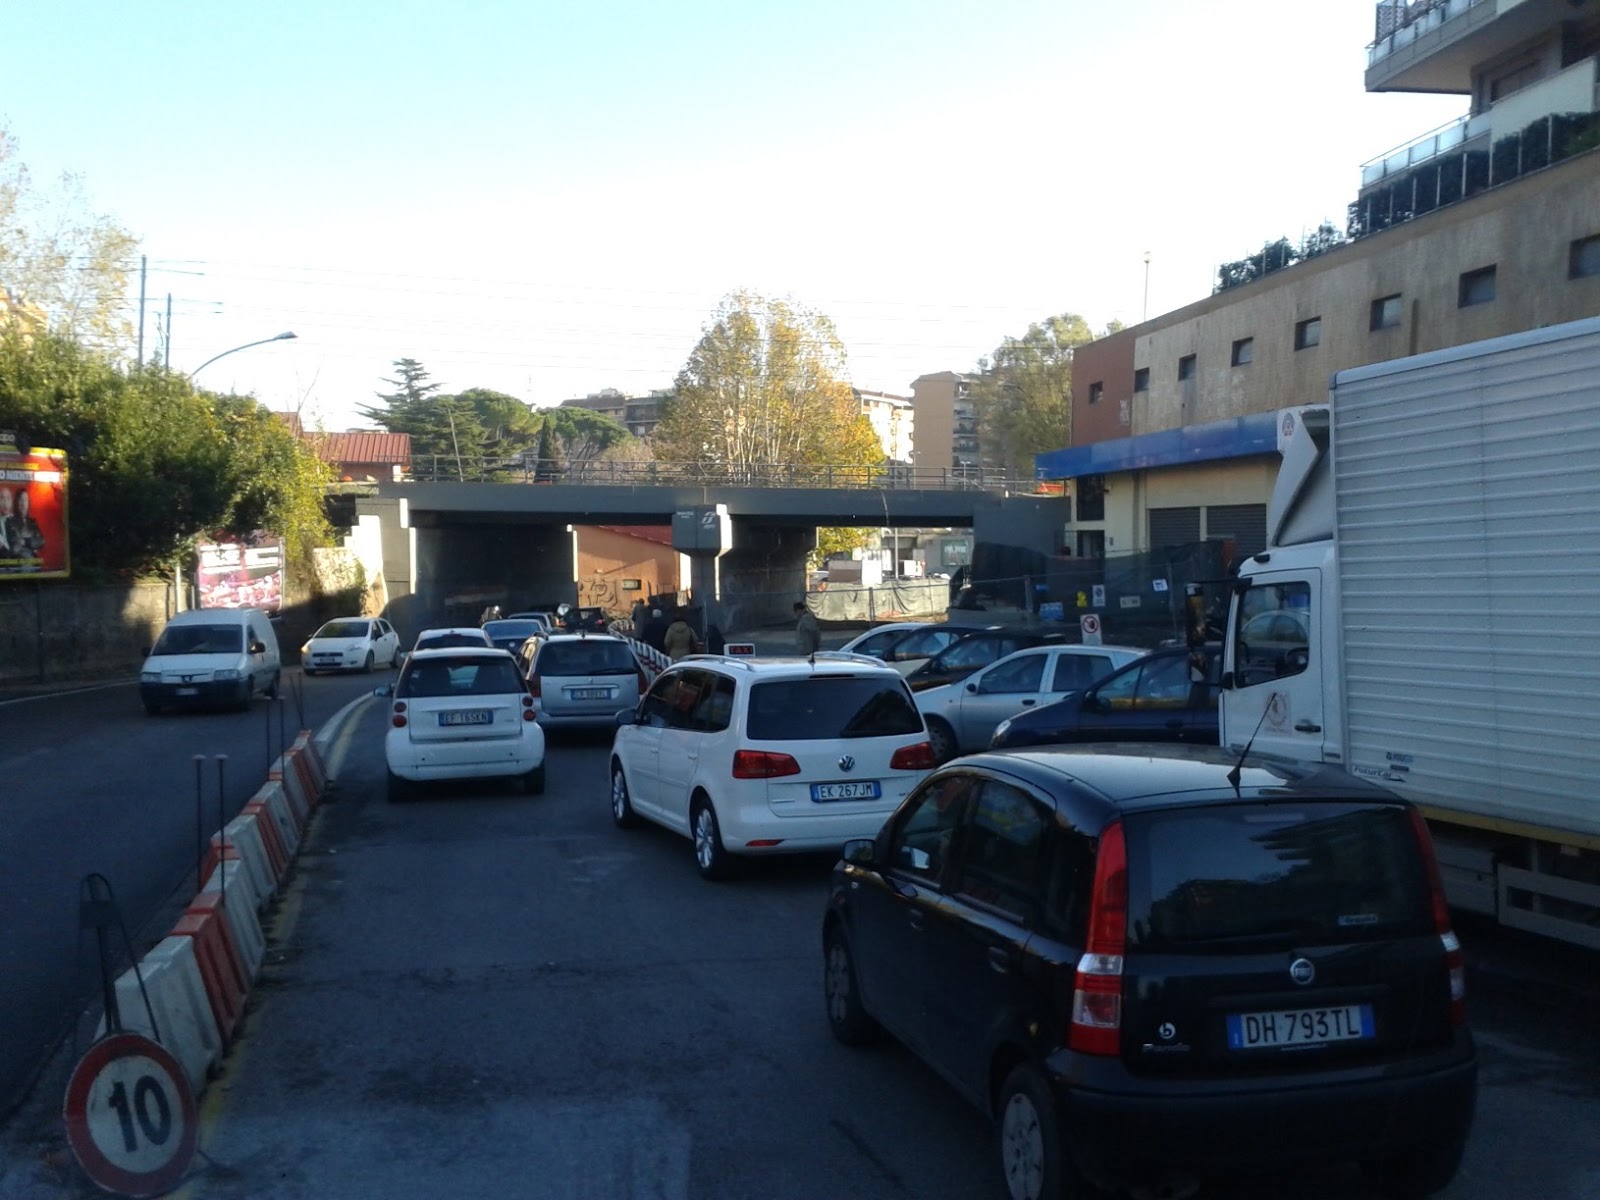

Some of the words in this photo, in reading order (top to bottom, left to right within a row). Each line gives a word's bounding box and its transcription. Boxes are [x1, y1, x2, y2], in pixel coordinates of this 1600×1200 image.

[730, 646, 753, 654] TAXI
[820, 786, 834, 798] EK
[838, 783, 873, 797] 267JM
[1246, 1014, 1277, 1044] DH
[1284, 1009, 1360, 1041] 793TL
[107, 1075, 172, 1153] 10
